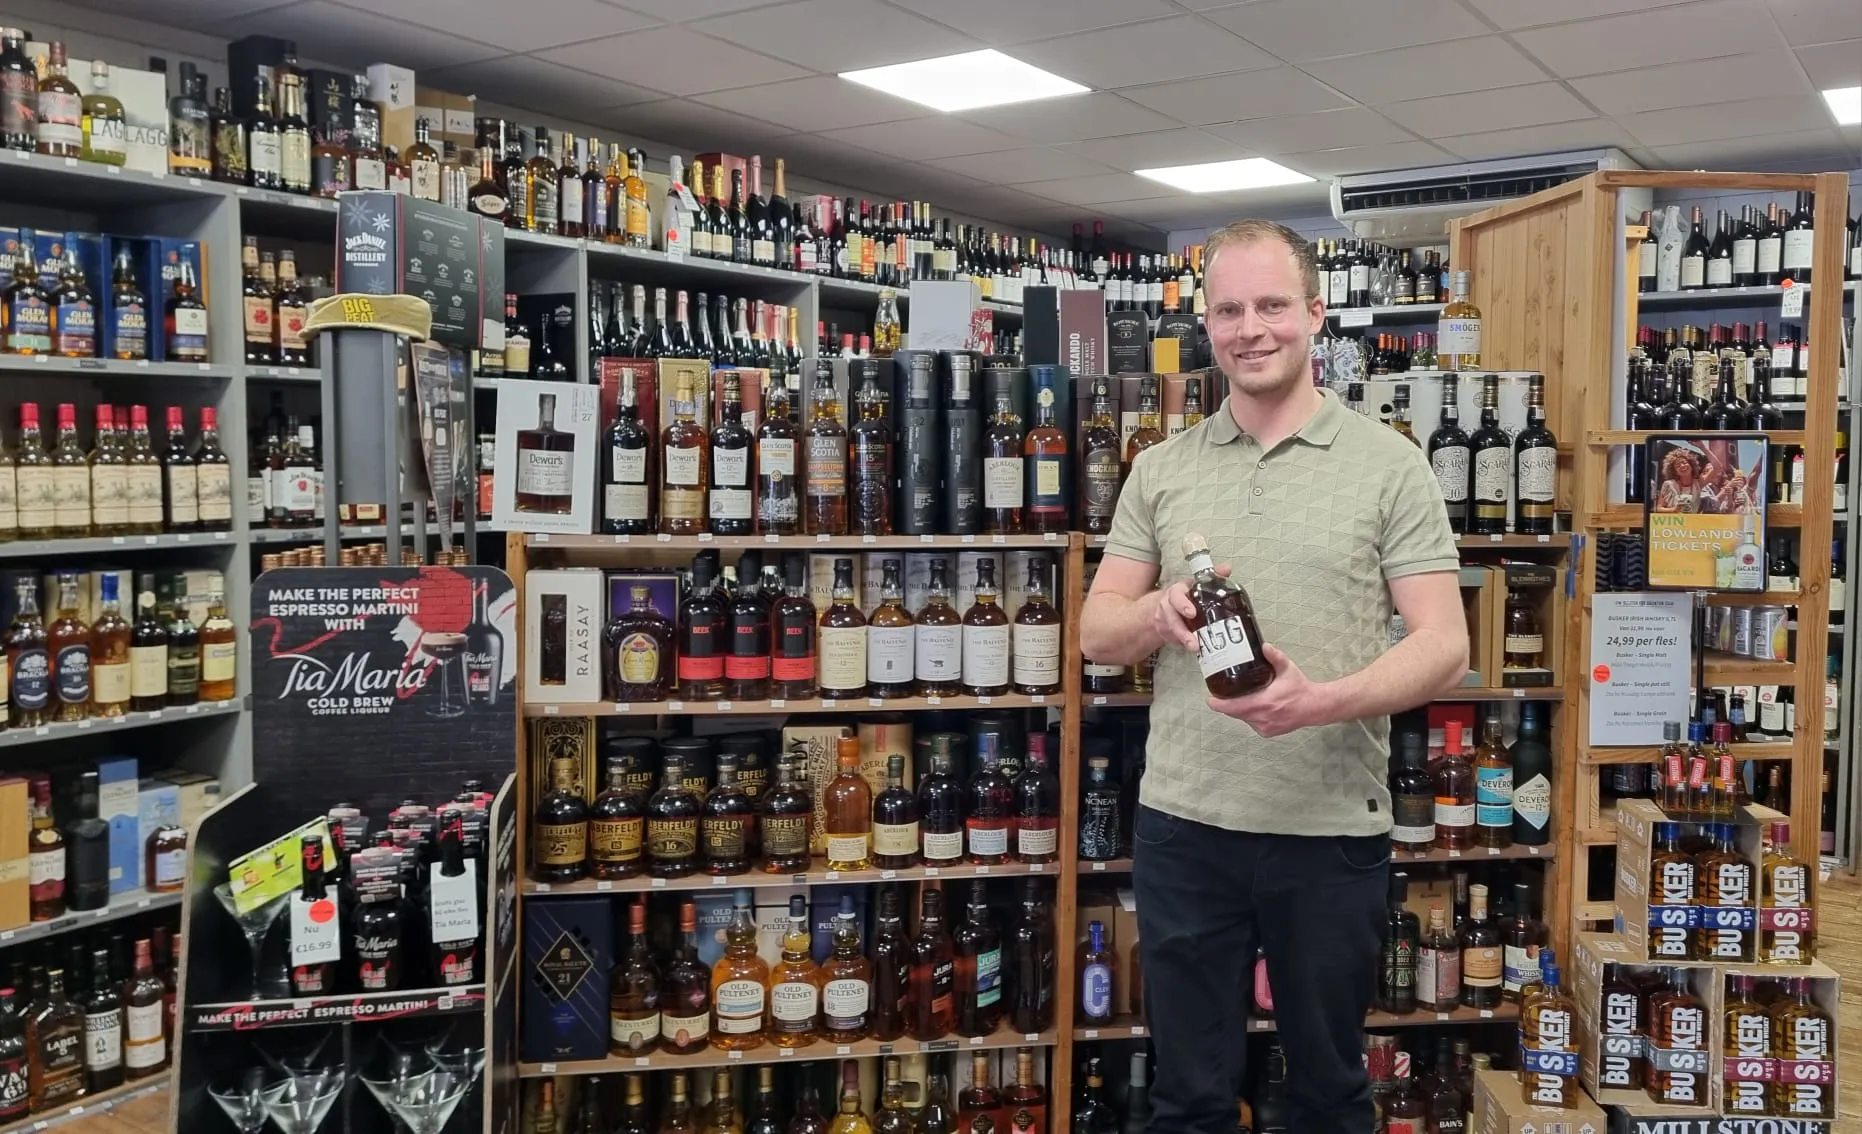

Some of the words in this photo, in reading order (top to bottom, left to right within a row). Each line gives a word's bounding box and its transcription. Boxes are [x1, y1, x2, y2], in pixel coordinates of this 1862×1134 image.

[125, 125, 168, 147] LAGG
[345, 252, 386, 262] DISTILLERY
[342, 297, 372, 313] BIG
[345, 311, 375, 322] PEAT
[581, 412, 593, 422] 27
[813, 438, 836, 448] GLEN
[615, 452, 643, 462] Dewar's
[669, 452, 697, 463] Dewar's
[716, 454, 744, 463] Dewar's
[810, 448, 840, 457] SCOTIA
[529, 453, 563, 465] Dewar's
[1652, 516, 1685, 526] WIN
[1651, 528, 1745, 539] LOWLANDS
[1651, 541, 1722, 551] TICKETS
[268, 588, 314, 601] MAKE
[317, 588, 349, 600] THE
[352, 587, 420, 600] PERFECT
[269, 603, 349, 616] ESPRESSO
[352, 603, 419, 615] MARTINI
[324, 618, 365, 630] WITH
[576, 604, 590, 677] RAASAY
[1196, 616, 1244, 658] AGG
[1606, 636, 1634, 647] 24,99
[1636, 638, 1654, 647] per
[1656, 635, 1678, 646] fles!
[270, 653, 332, 699] Tia
[321, 651, 427, 698] Maria
[307, 698, 349, 708] COLD
[353, 696, 394, 707] BREW
[703, 820, 744, 830] ERFELDY
[550, 842, 568, 855] 25
[665, 840, 677, 850] 16
[712, 908, 732, 916] OLD
[1661, 862, 1687, 955] BUSKER
[1717, 863, 1743, 957] BUSKER
[1773, 866, 1800, 960] BUSKER
[434, 921, 447, 929] Tia
[448, 919, 471, 927] Maria
[295, 940, 332, 954] €16.99
[366, 936, 398, 951] Maria
[557, 973, 571, 984] 21
[1517, 969, 1540, 977] WHISK
[730, 983, 749, 991] OLD
[827, 986, 865, 997] PULTENEY
[838, 982, 855, 990] OLD
[719, 988, 760, 997] PULTENEY
[774, 990, 813, 1000] PULTENEY
[198, 1013, 232, 1024] MAKE
[233, 1011, 257, 1022] THE
[258, 1008, 309, 1020] PERFECT
[314, 1003, 375, 1017] ESPRESSO
[46, 1035, 79, 1052] LABEL
[1605, 993, 1632, 1085] BUSKER
[1537, 1009, 1565, 1103] BUSKER
[1669, 1007, 1698, 1101] BUSKER
[1737, 1014, 1764, 1110] BUSKER
[1794, 1017, 1821, 1113] BUSKER
[1439, 1119, 1463, 1129] BAIN'S
